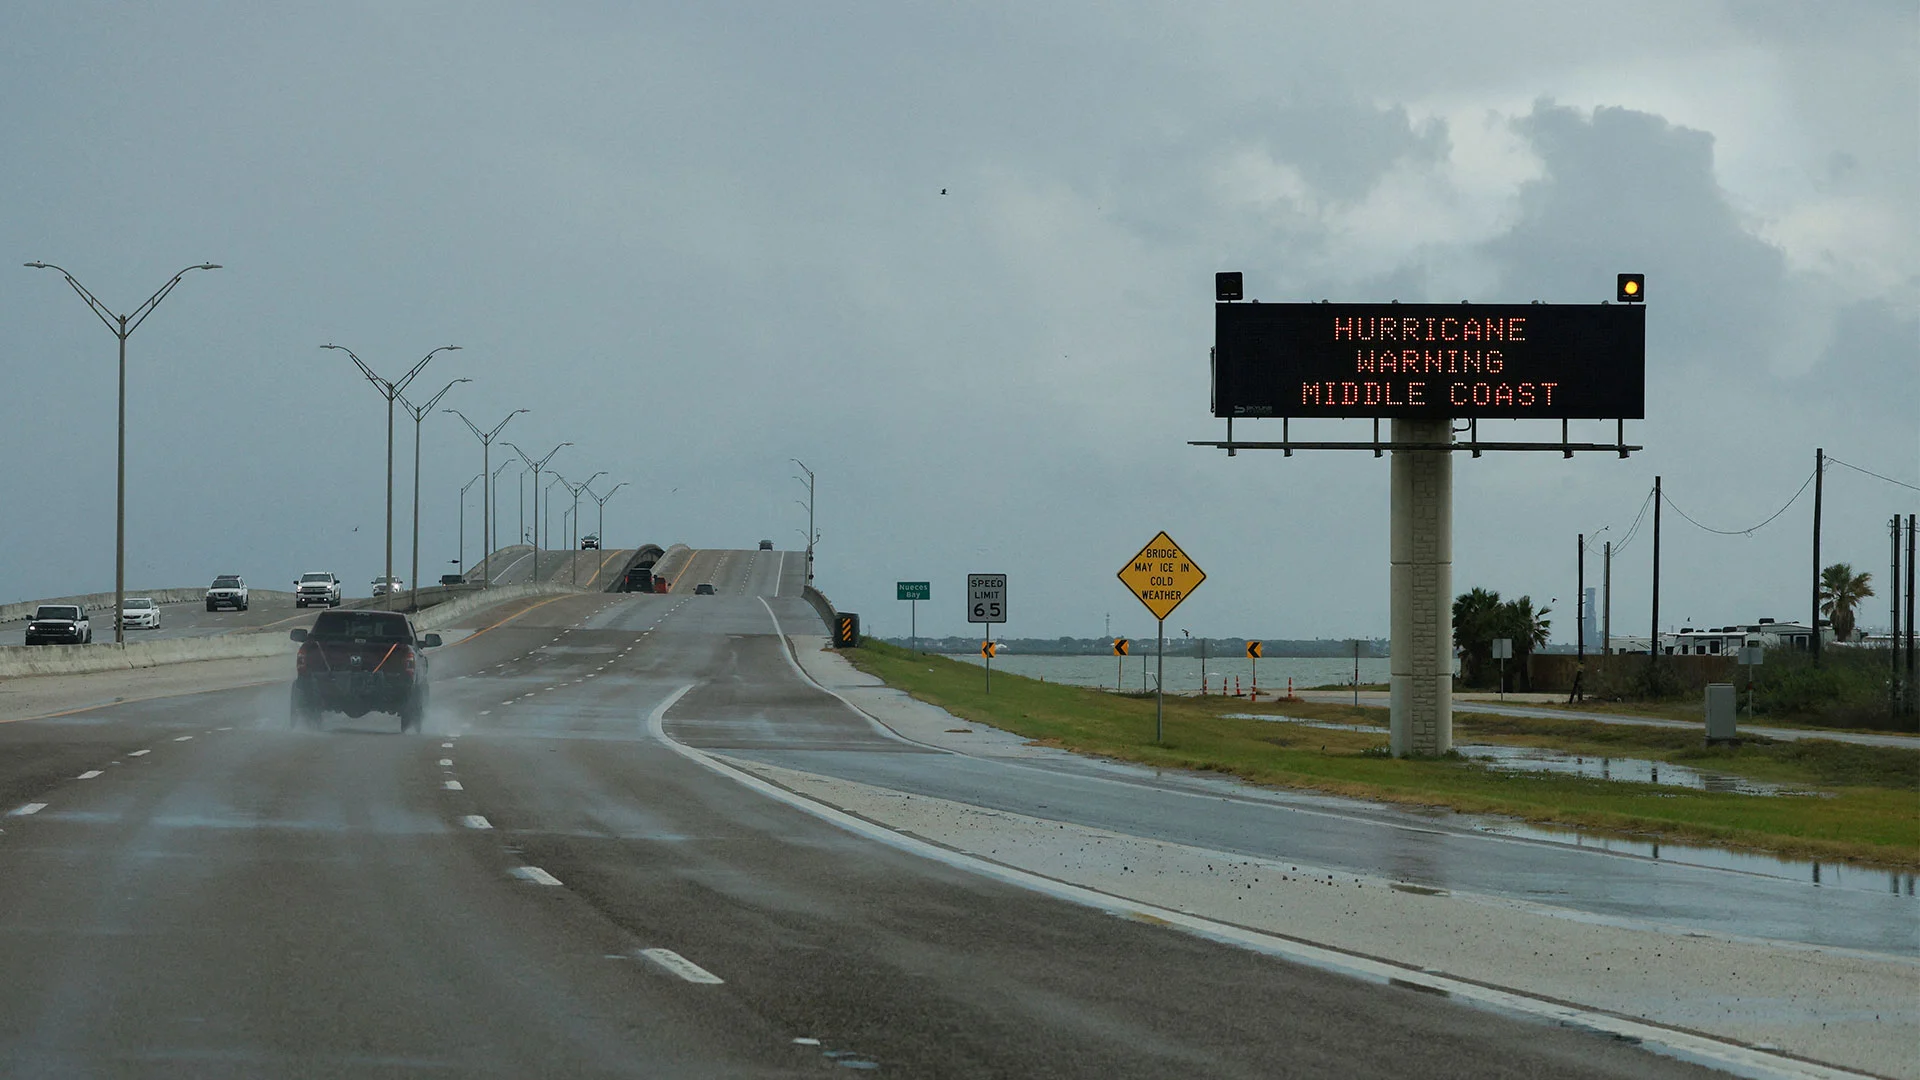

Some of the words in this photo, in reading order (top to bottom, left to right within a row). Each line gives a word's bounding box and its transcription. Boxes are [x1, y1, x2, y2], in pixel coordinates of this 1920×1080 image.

[1334, 317, 1527, 341] HURRICANE
[1357, 350, 1504, 374] WARNING
[1302, 382, 1426, 406] MIDDLE
[1451, 382, 1559, 406] COAST
[1146, 549, 1178, 558] BRIDGE
[1134, 562, 1153, 572] MAY
[1160, 562, 1174, 572] ICE
[1180, 563, 1190, 573] IN
[971, 579, 1004, 588] SPEED
[1150, 576, 1174, 586] COLD
[906, 591, 921, 599] Bay
[974, 591, 999, 599] LIMIT
[1141, 590, 1182, 600] WEATHER
[973, 602, 1001, 617] 65
